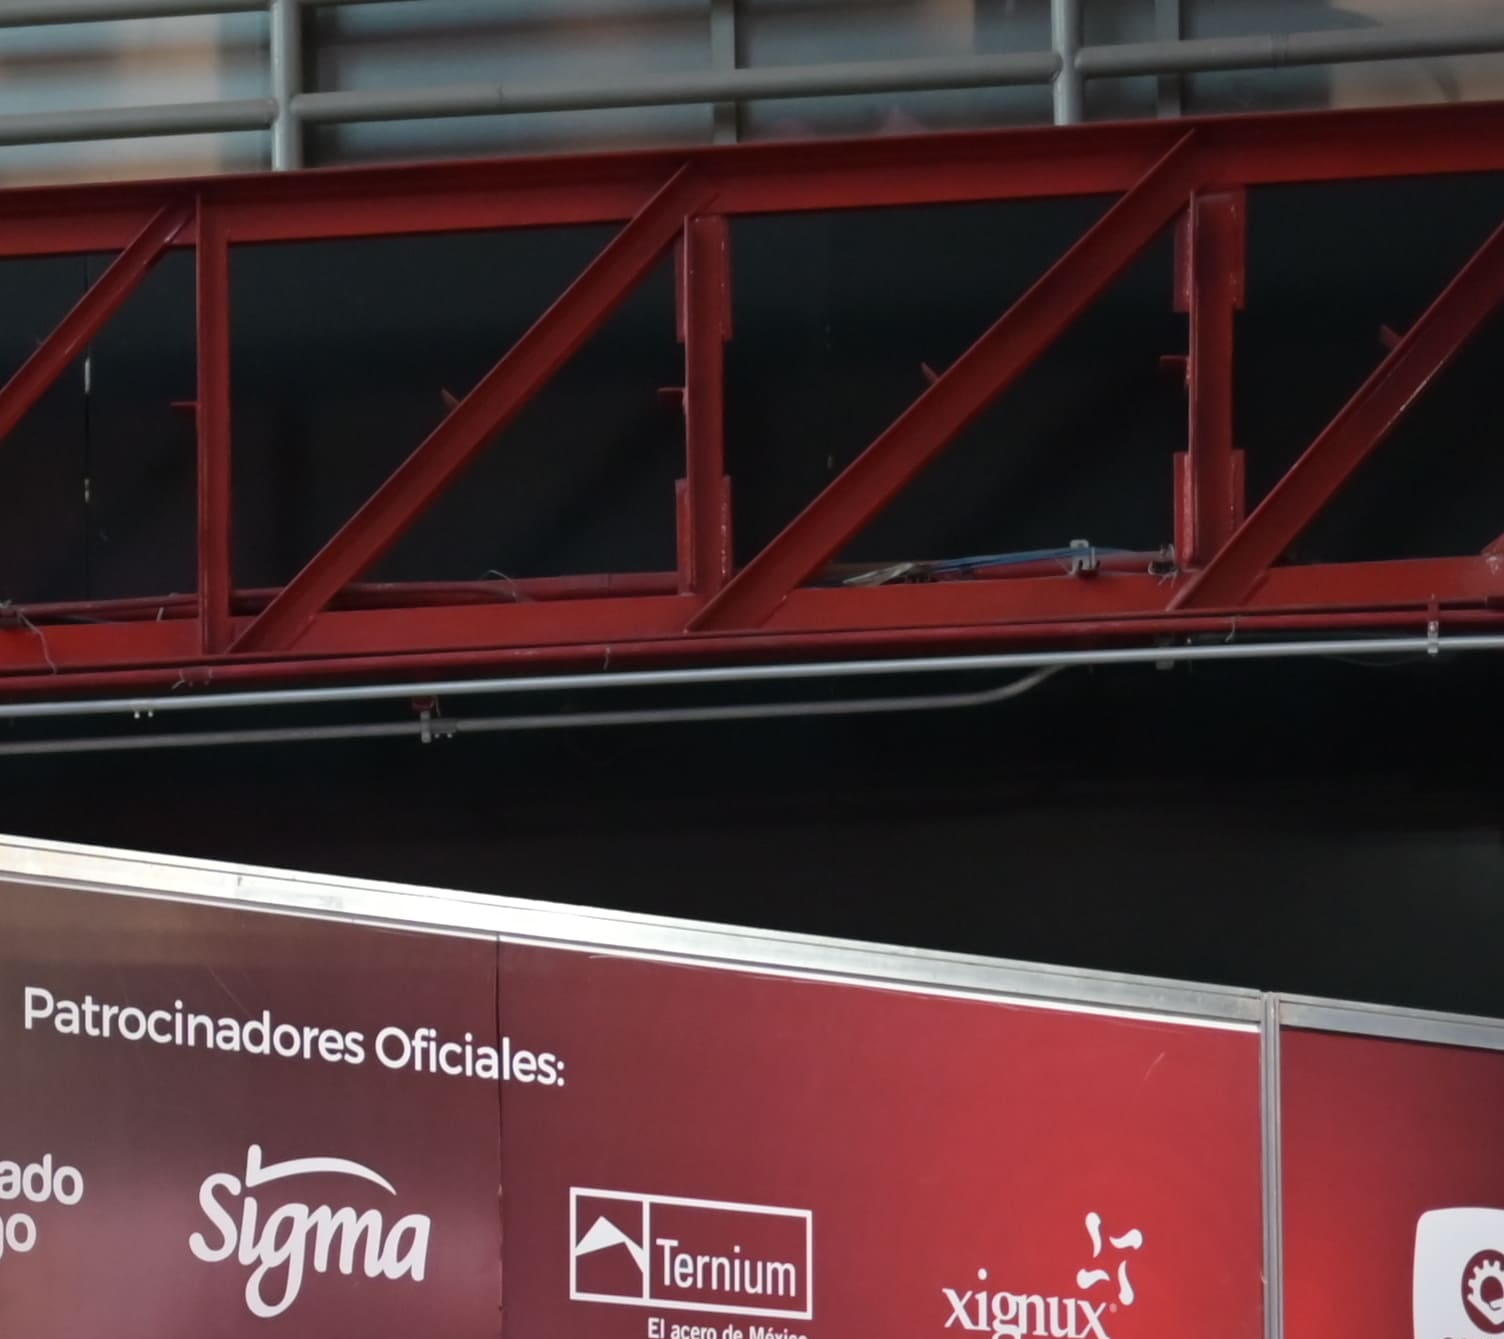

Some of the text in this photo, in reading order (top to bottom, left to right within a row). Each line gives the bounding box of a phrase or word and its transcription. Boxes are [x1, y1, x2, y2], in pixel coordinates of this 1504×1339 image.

[24, 986, 565, 1087] Patrocinadores Oficiales:
[188, 1144, 431, 1318] Sigma
[655, 1238, 796, 1298] Ternium
[647, 1317, 665, 1339] El
